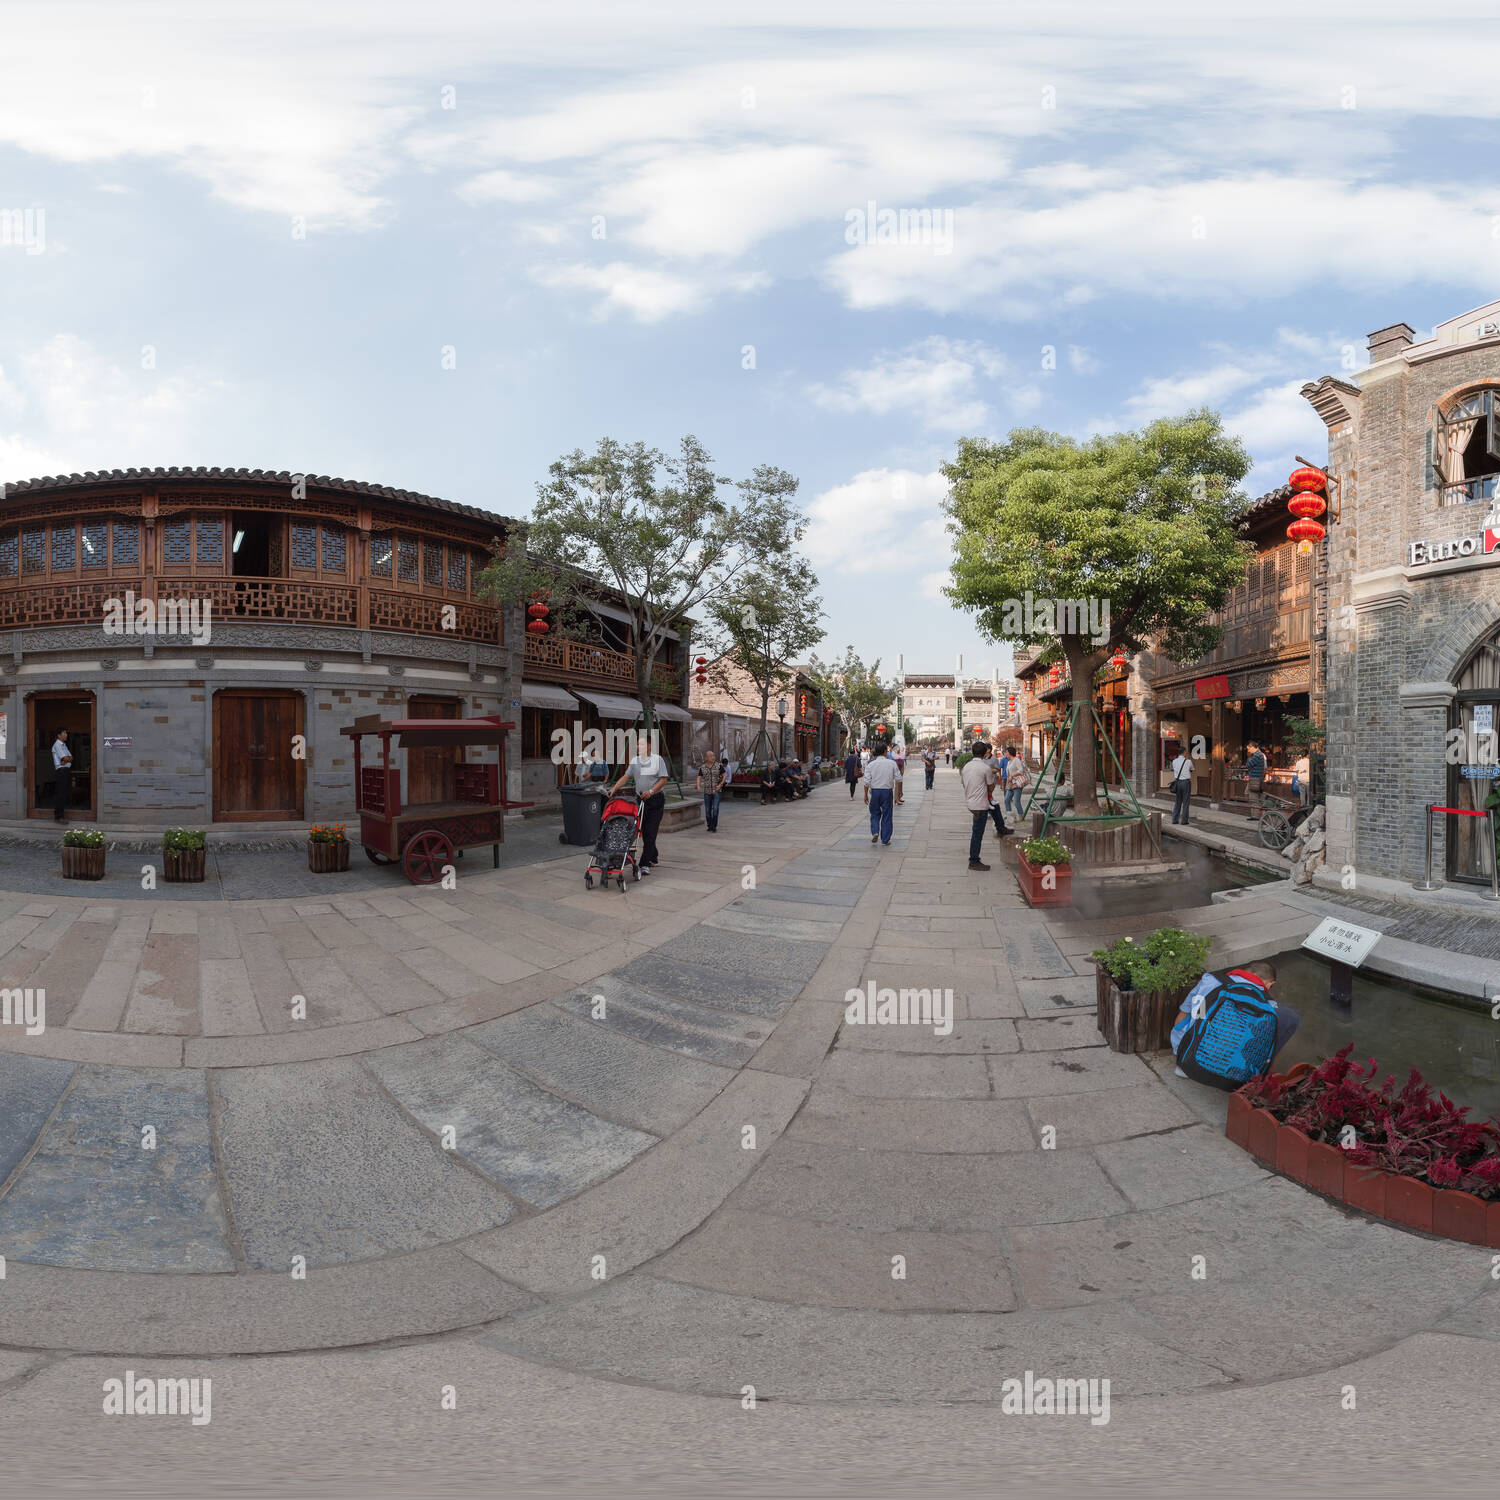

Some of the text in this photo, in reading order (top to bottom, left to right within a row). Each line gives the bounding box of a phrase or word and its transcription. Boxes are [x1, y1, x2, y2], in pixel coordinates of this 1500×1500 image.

[1328, 925, 1361, 942] 请勿嬉戏
[1320, 936, 1353, 953] 小心落水
